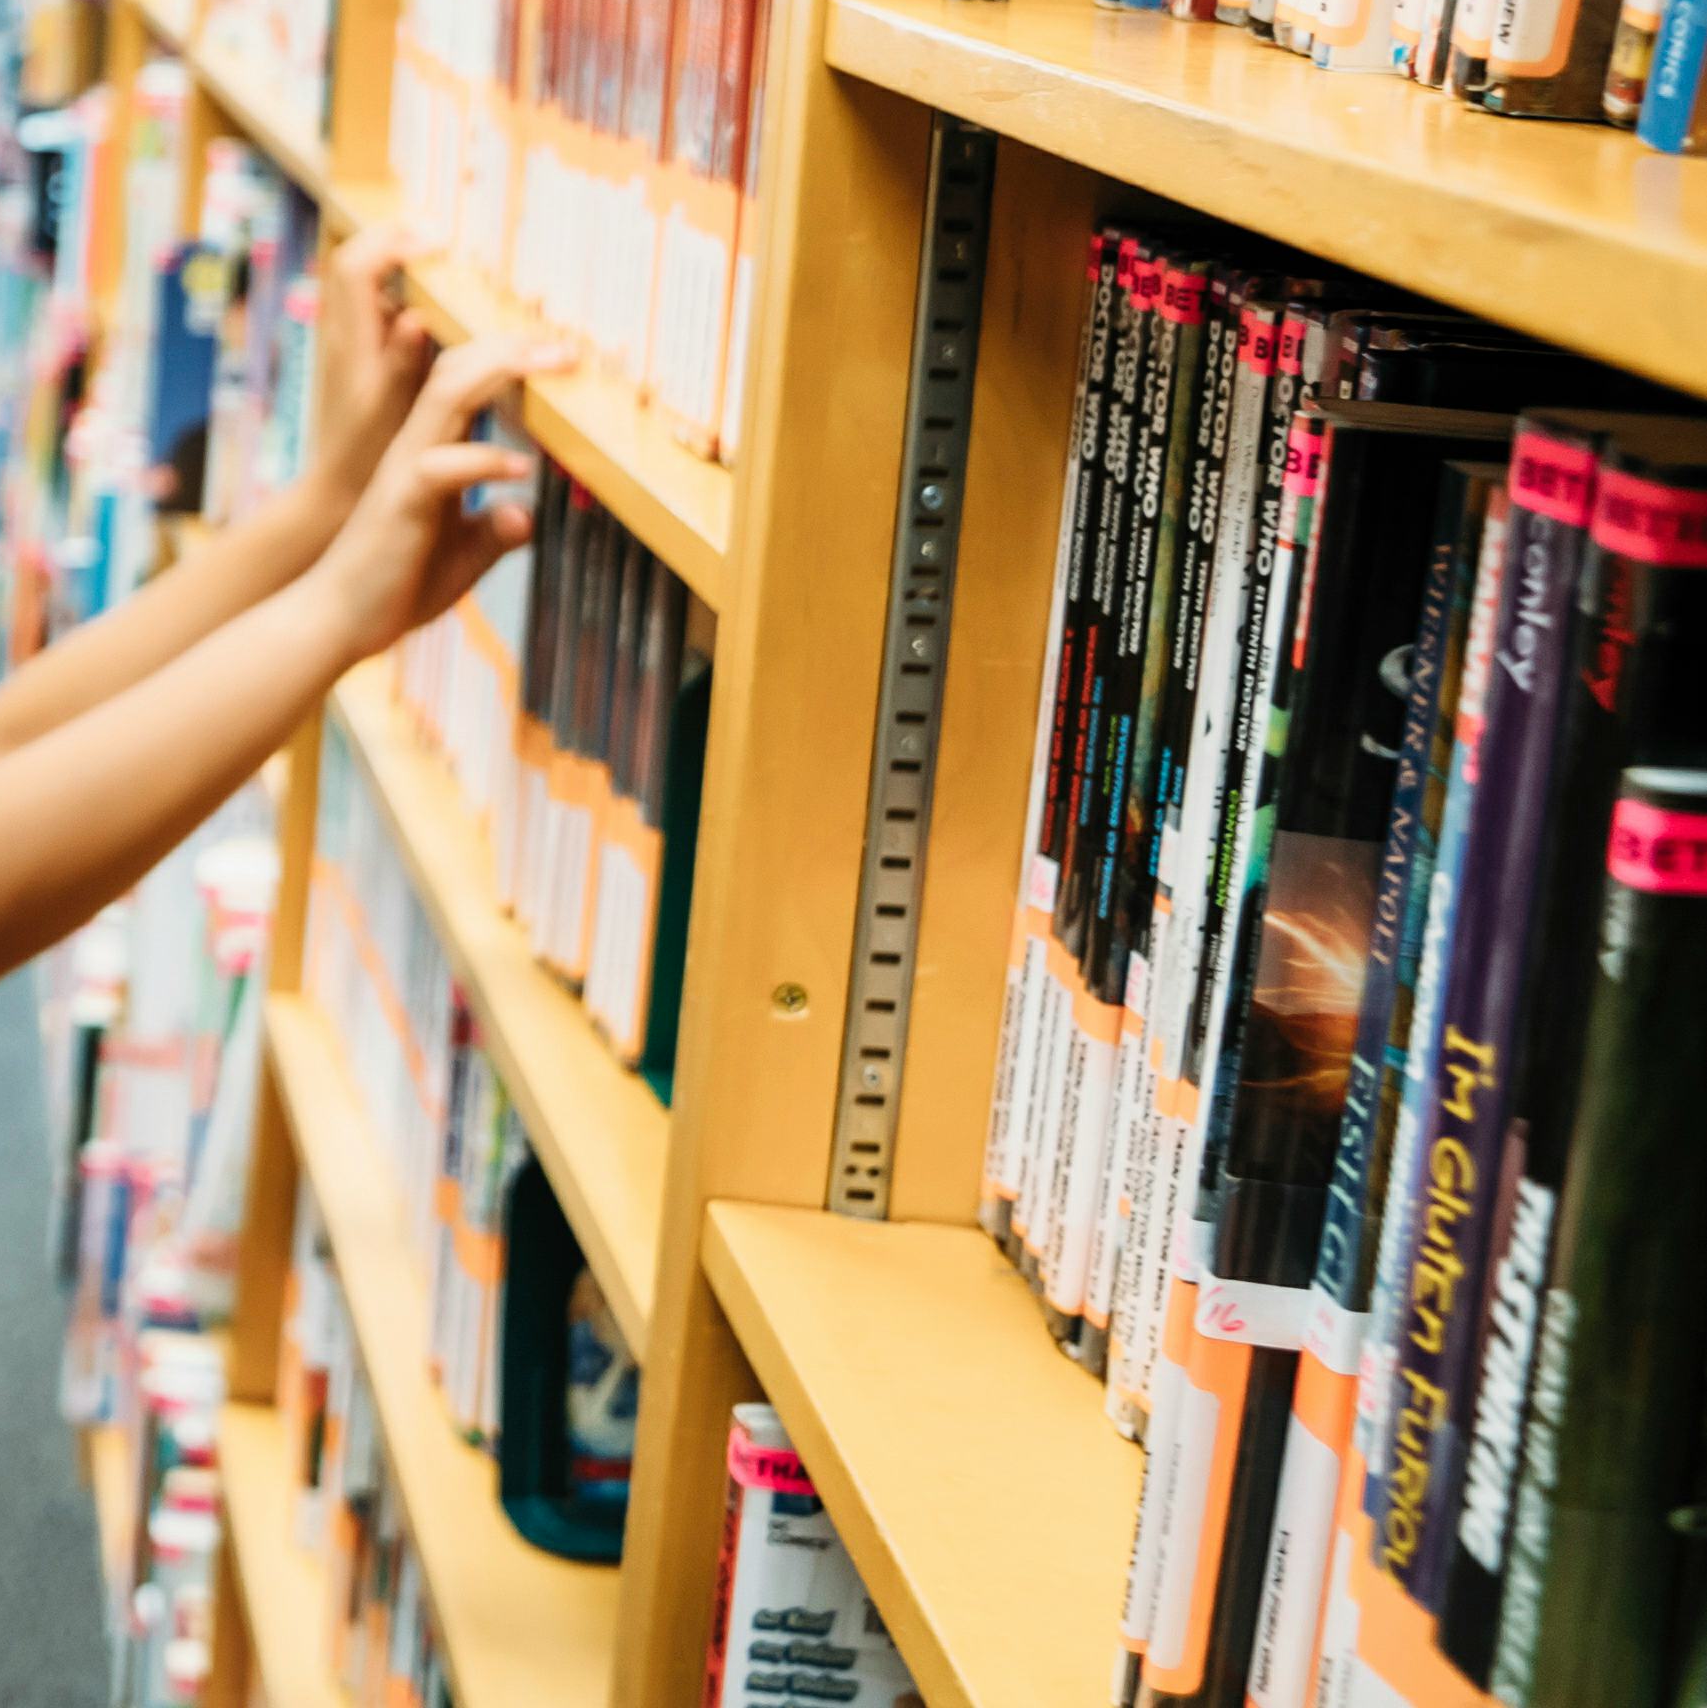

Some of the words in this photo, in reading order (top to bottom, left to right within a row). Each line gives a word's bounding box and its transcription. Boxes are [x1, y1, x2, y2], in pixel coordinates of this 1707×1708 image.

[1090, 265, 1113, 381] DOCTOR
[1121, 308, 1144, 402] OCTOR
[1196, 320, 1222, 446] DOCTOR
[1210, 330, 1237, 458] DOCTOR
[1081, 391, 1100, 459] WHO
[1113, 414, 1132, 483] WHO
[1265, 375, 1294, 486] OCTOR
[1142, 446, 1163, 517] WHO
[1186, 459, 1207, 530] WHO
[1200, 470, 1220, 542] WHO
[1136, 527, 1152, 576] TENTH
[1181, 540, 1196, 590] TENTH
[1255, 500, 1279, 575] WHO
[1128, 580, 1146, 653] DOCTOR
[1194, 560, 1208, 611] TENTH
[1172, 595, 1189, 668] DOCTOR
[1184, 616, 1202, 689] DOCTOR
[1245, 585, 1266, 668] ELEVENTH
[1402, 543, 1452, 752] WIESNER
[1234, 674, 1255, 749] DOCTOR
[1215, 789, 1241, 908] CONVERSION
[1370, 805, 1416, 966] NAPOLI
[1148, 1116, 1163, 1164] YAGN
[1170, 1129, 1186, 1177] YAGN
[1328, 1053, 1376, 1217] FISH
[1136, 1171, 1155, 1247] DOCTOR
[1158, 1184, 1179, 1262] DOCTOR
[1151, 1268, 1166, 1310] WHO
[1457, 1256, 1540, 1577] STINKING
